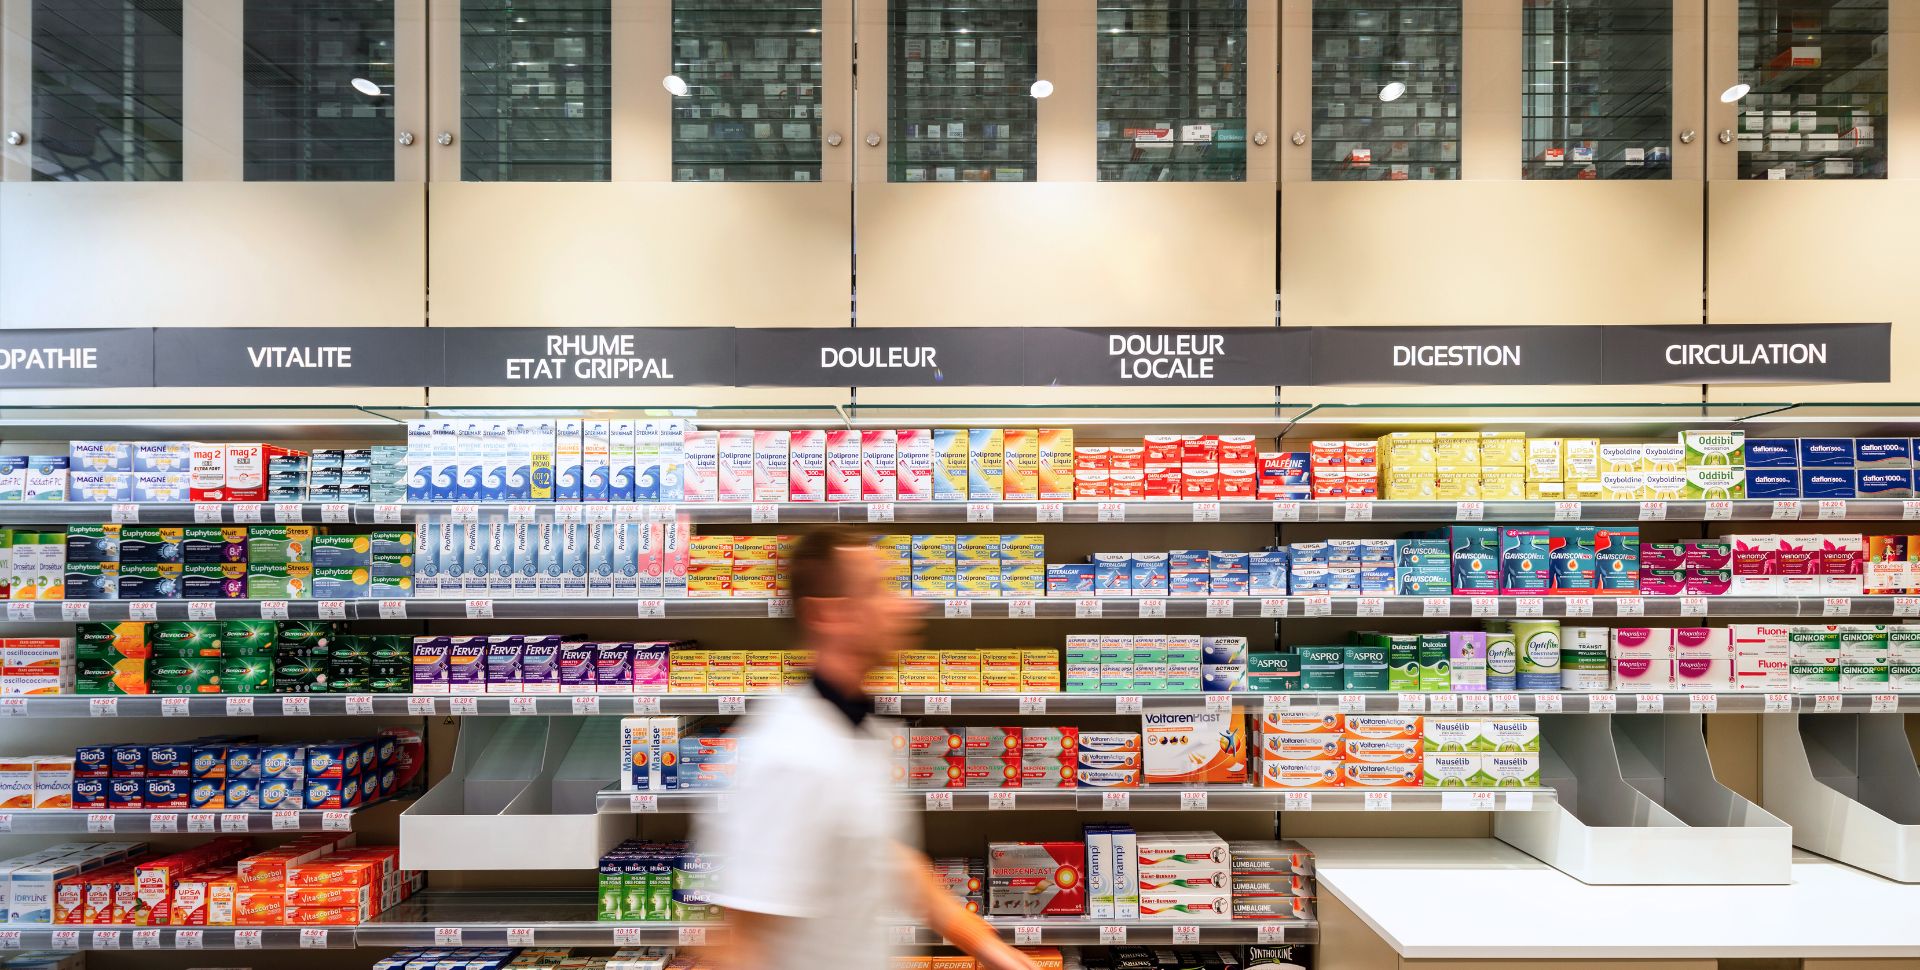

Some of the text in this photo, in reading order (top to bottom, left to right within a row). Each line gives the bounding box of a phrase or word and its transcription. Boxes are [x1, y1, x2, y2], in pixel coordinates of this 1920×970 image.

[547, 335, 634, 356] RHUME
[1109, 335, 1225, 356] DOULEUR
[247, 346, 352, 368] VITALITE
[821, 347, 937, 368] DOULEUR
[1393, 345, 1520, 366] DIGESTION
[1665, 343, 1827, 365] CIRCULATION
[506, 359, 673, 380] ETAT GRIPPAL
[1120, 358, 1214, 378] LOCALE
[1700, 436, 1733, 445] Oddibil
[194, 452, 212, 460] mag
[230, 449, 248, 458] mag
[1700, 471, 1733, 480] Oddibil
[316, 536, 354, 544] Euphytose
[251, 564, 286, 572] Euphytose
[1758, 627, 1787, 635] Fluon+
[1794, 634, 1824, 642] GINKOR
[415, 646, 448, 655] FERVEX
[490, 645, 522, 655] FERVEX
[526, 645, 558, 655] FERVEX
[563, 651, 591, 660] FERVEX
[636, 651, 665, 660] FERVEX
[1310, 652, 1339, 660] ASPRO
[1354, 652, 1383, 660] ASPRO
[1758, 660, 1788, 668] Fluon+
[1436, 723, 1469, 731] Nausélib
[623, 728, 631, 772] Maxilase
[651, 728, 660, 772] Maxilase
[81, 752, 104, 760] Bion3
[152, 751, 177, 760] Bion3
[78, 783, 102, 792] Bion3
[150, 783, 175, 792] Bion3
[685, 862, 711, 870] HUMEX
[242, 870, 282, 884] Vitascorbol
[302, 890, 341, 903] Vitascorbol
[240, 903, 280, 915] Vitascorbol
[301, 908, 340, 921] Vitascorbol
